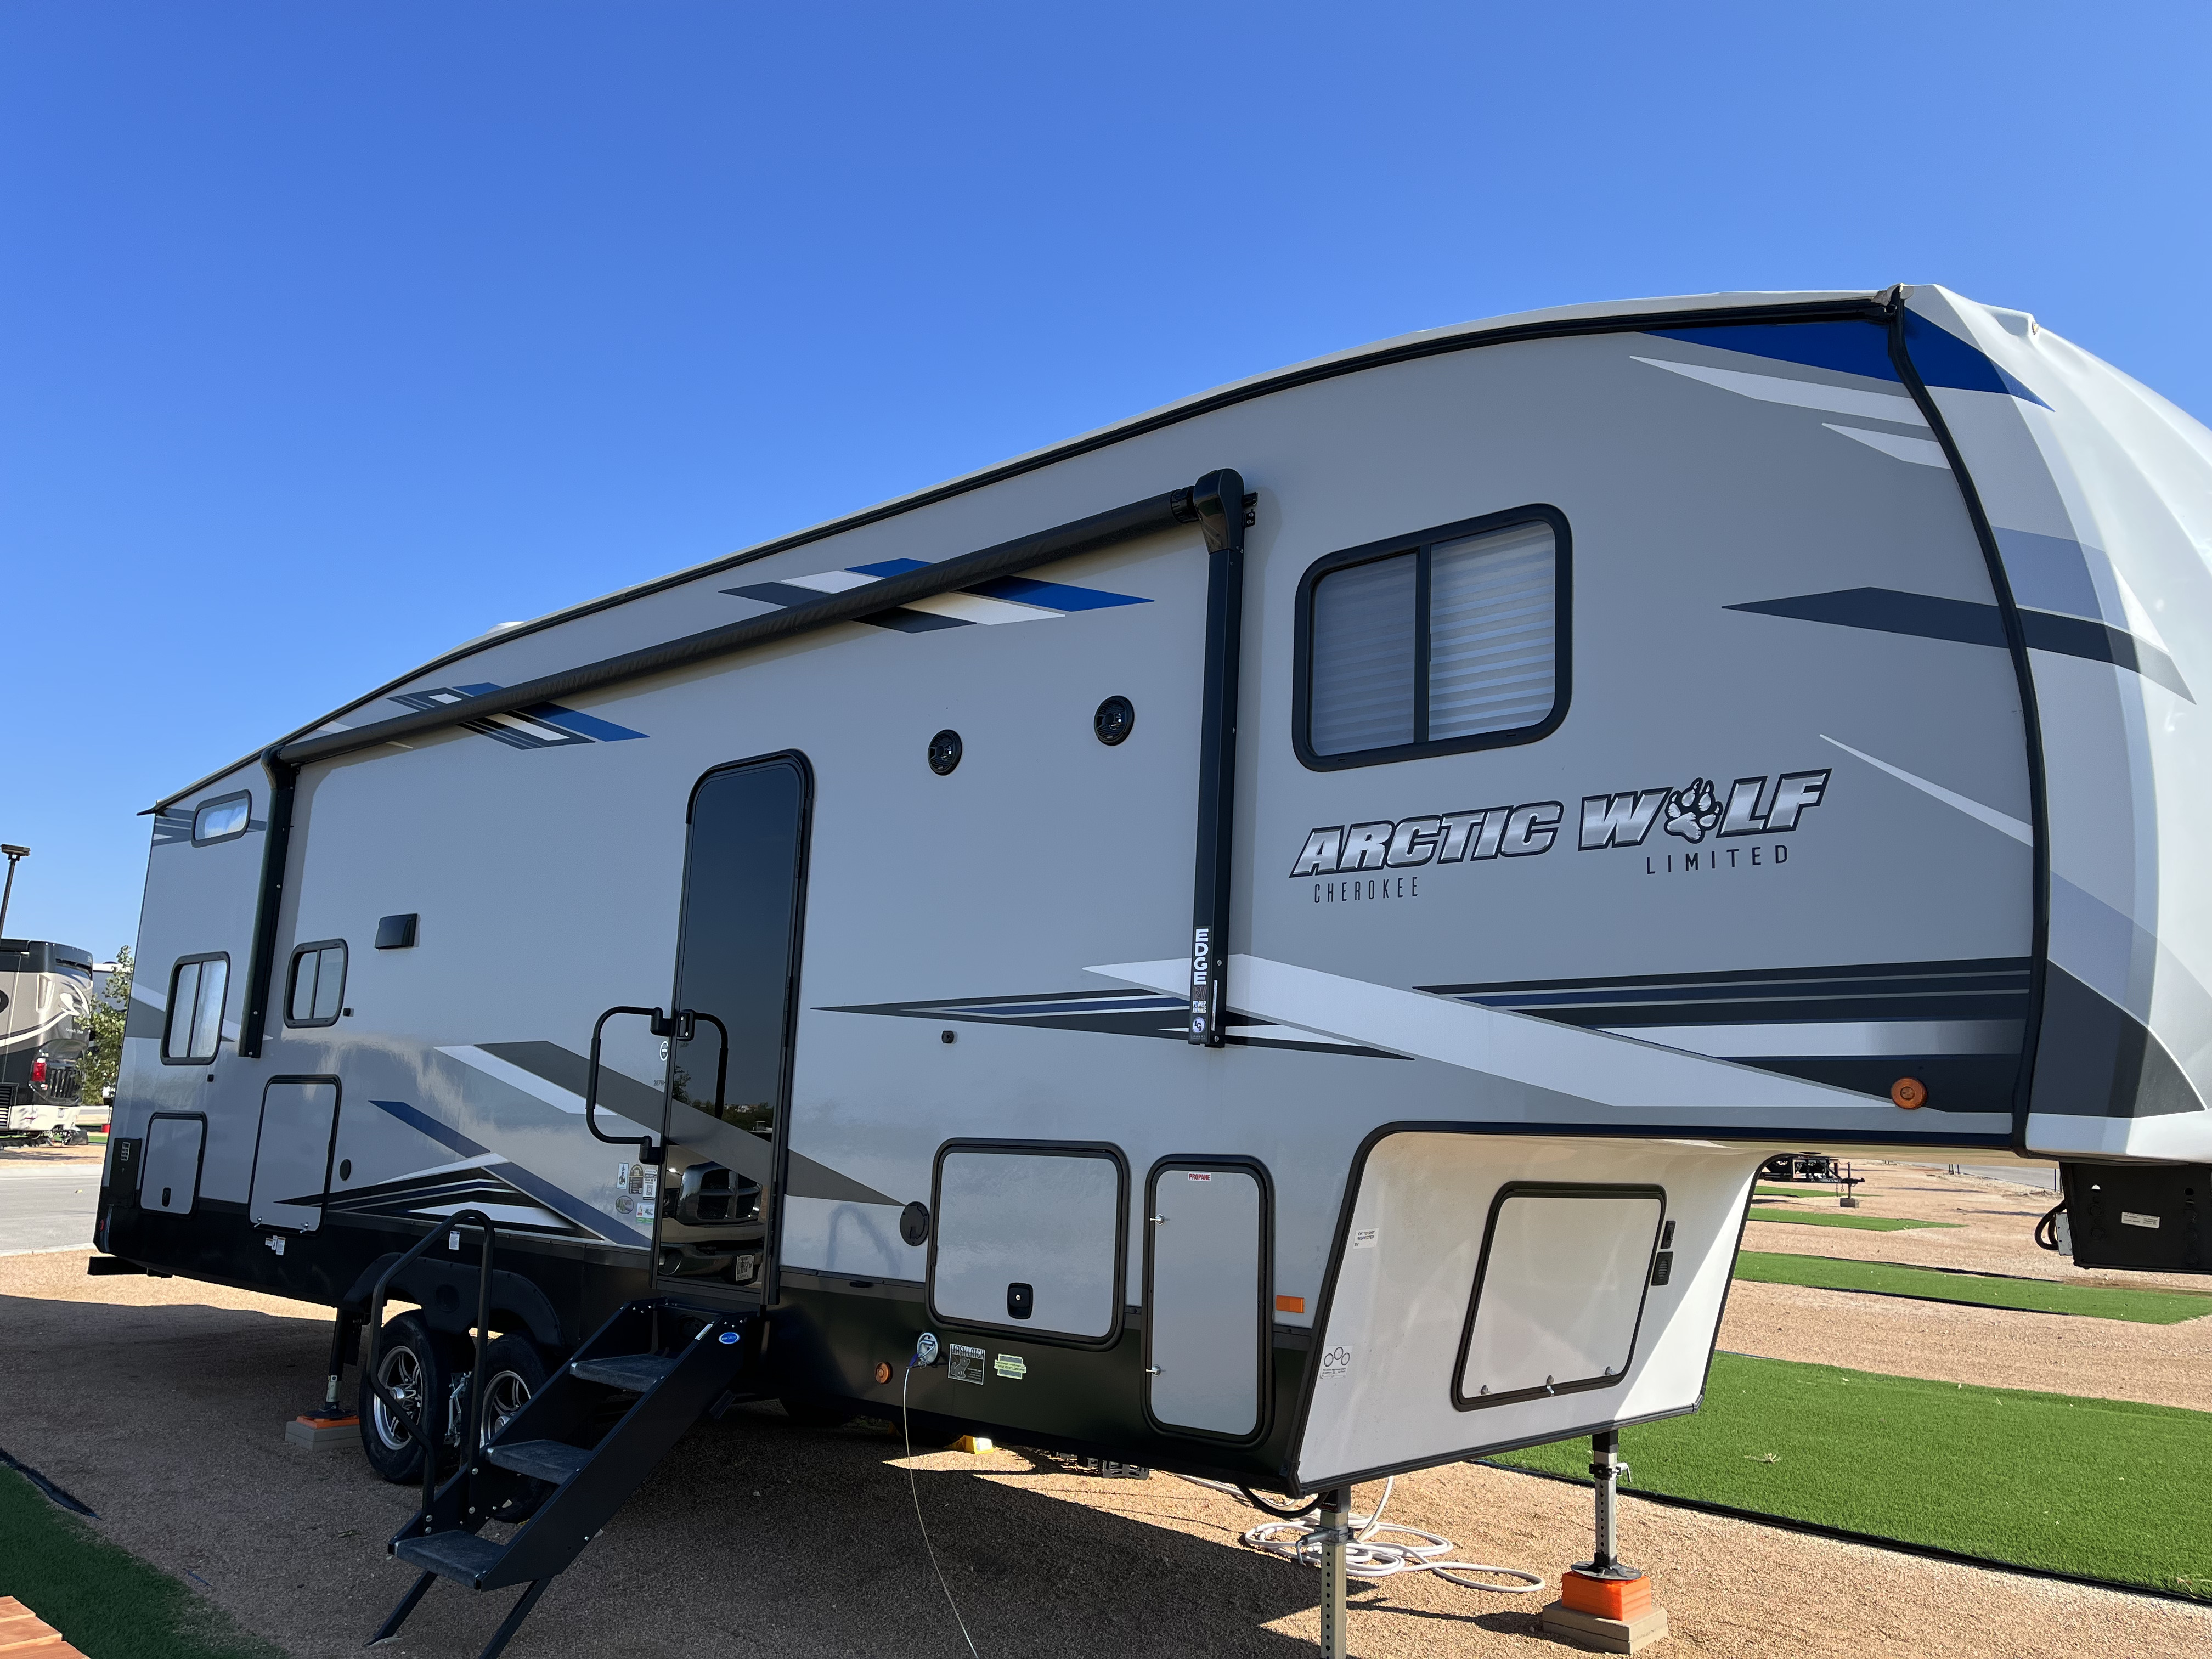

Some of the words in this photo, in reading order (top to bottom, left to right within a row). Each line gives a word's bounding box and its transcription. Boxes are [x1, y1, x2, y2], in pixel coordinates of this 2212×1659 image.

[1288, 800, 1564, 878] ARCTIC
[1646, 844, 1788, 874] LIMITED
[1314, 876, 1419, 904] CHEROKEE
[1194, 928, 1209, 985] EDGE
[1193, 986, 1207, 1001] 12V
